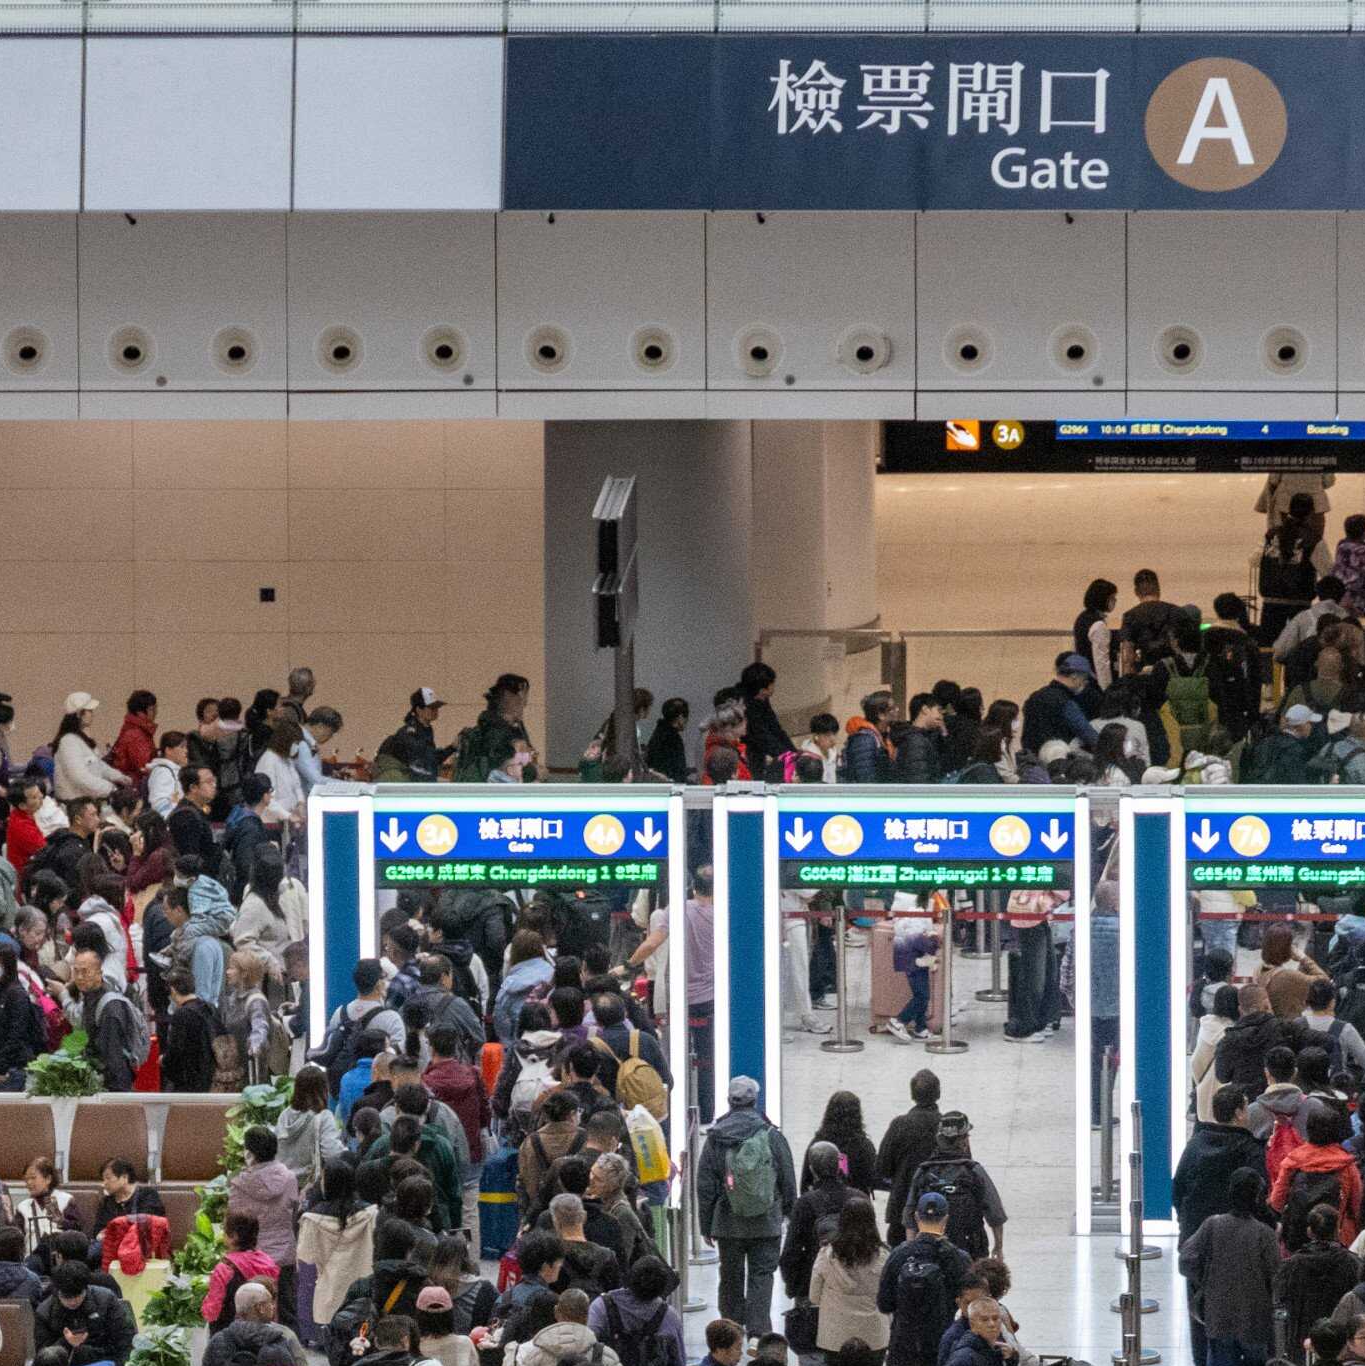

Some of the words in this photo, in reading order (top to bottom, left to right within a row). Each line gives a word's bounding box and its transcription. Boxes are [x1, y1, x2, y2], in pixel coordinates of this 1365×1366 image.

[768, 58, 1109, 136] 檢票閘口
[1176, 77, 1255, 165] A
[991, 147, 1109, 190] Gate
[997, 424, 1020, 443] 3A
[424, 824, 451, 846] 3A
[588, 824, 619, 846] 4A
[508, 842, 535, 854] Gate
[913, 842, 940, 854] Gate
[1320, 842, 1348, 855] Gate
